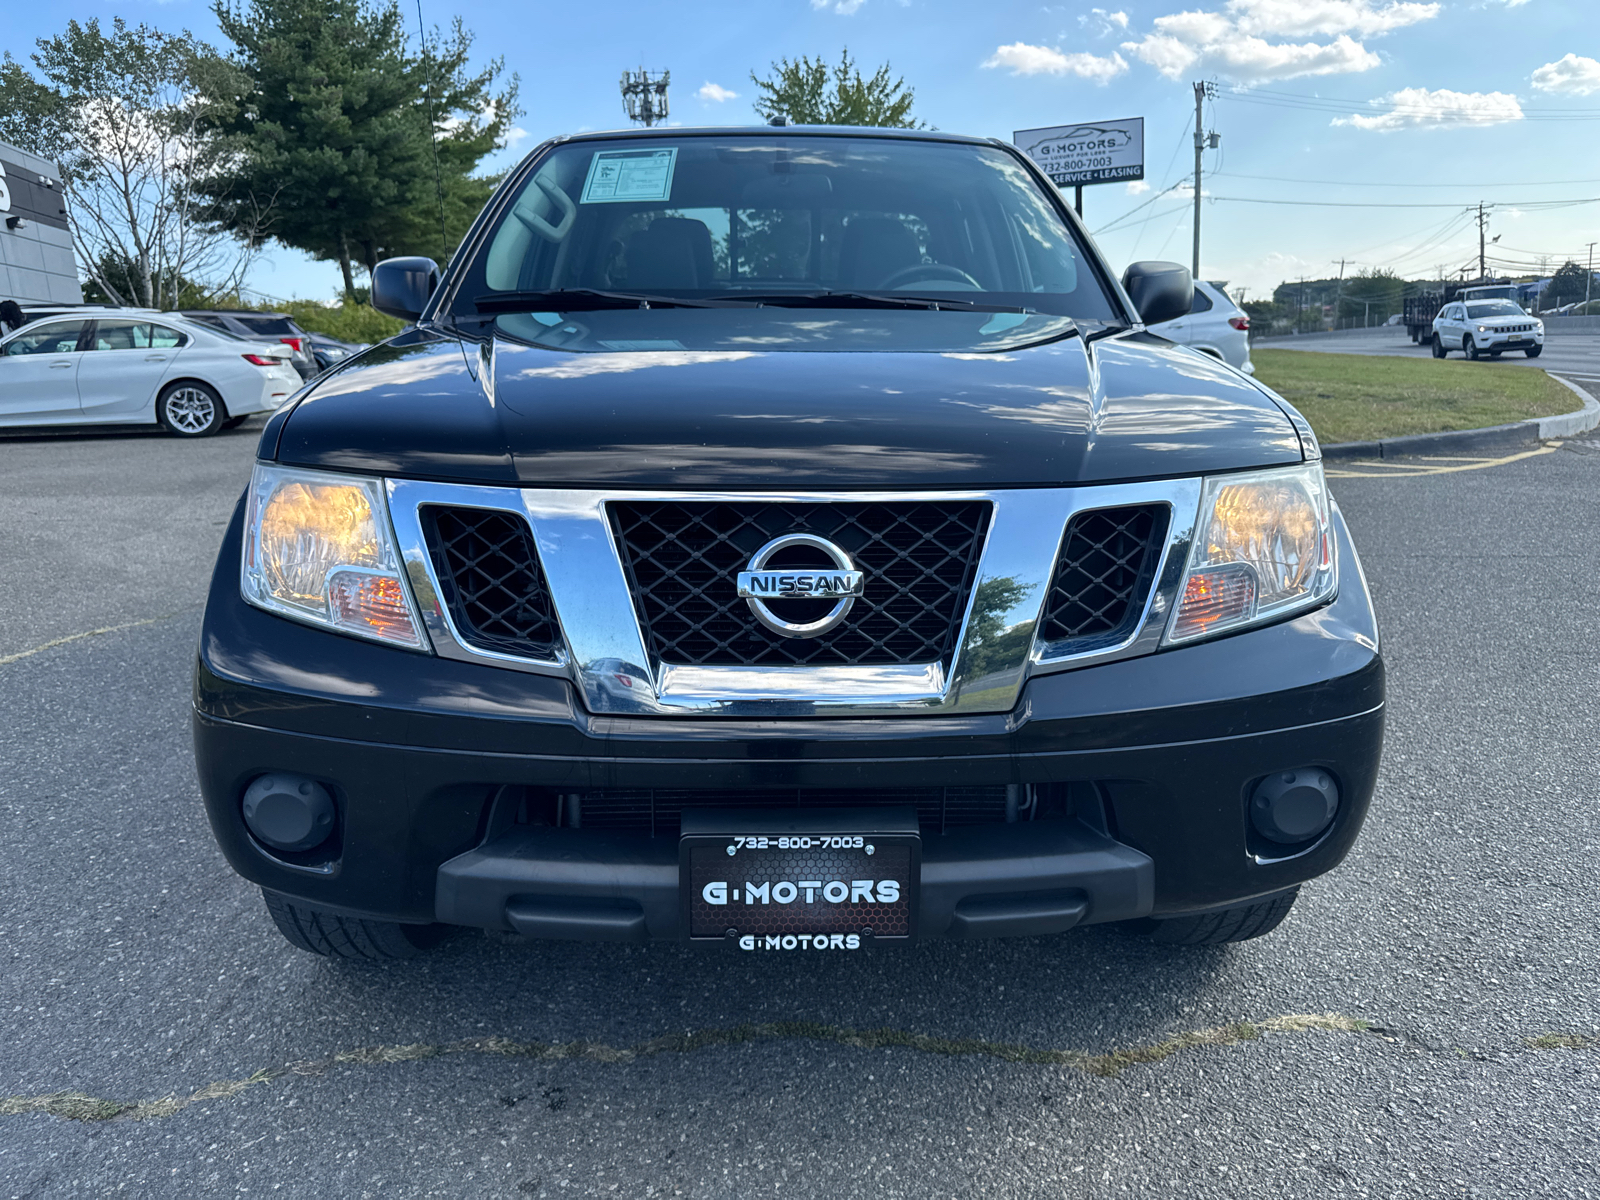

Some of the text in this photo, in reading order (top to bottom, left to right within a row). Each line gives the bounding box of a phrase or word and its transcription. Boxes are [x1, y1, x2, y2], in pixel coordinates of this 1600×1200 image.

[1042, 157, 1112, 173] 732-800-7003
[1053, 166, 1141, 184] SERVICE LEASING
[750, 576, 851, 592] NISSAN
[734, 836, 864, 849] 732-800-7003
